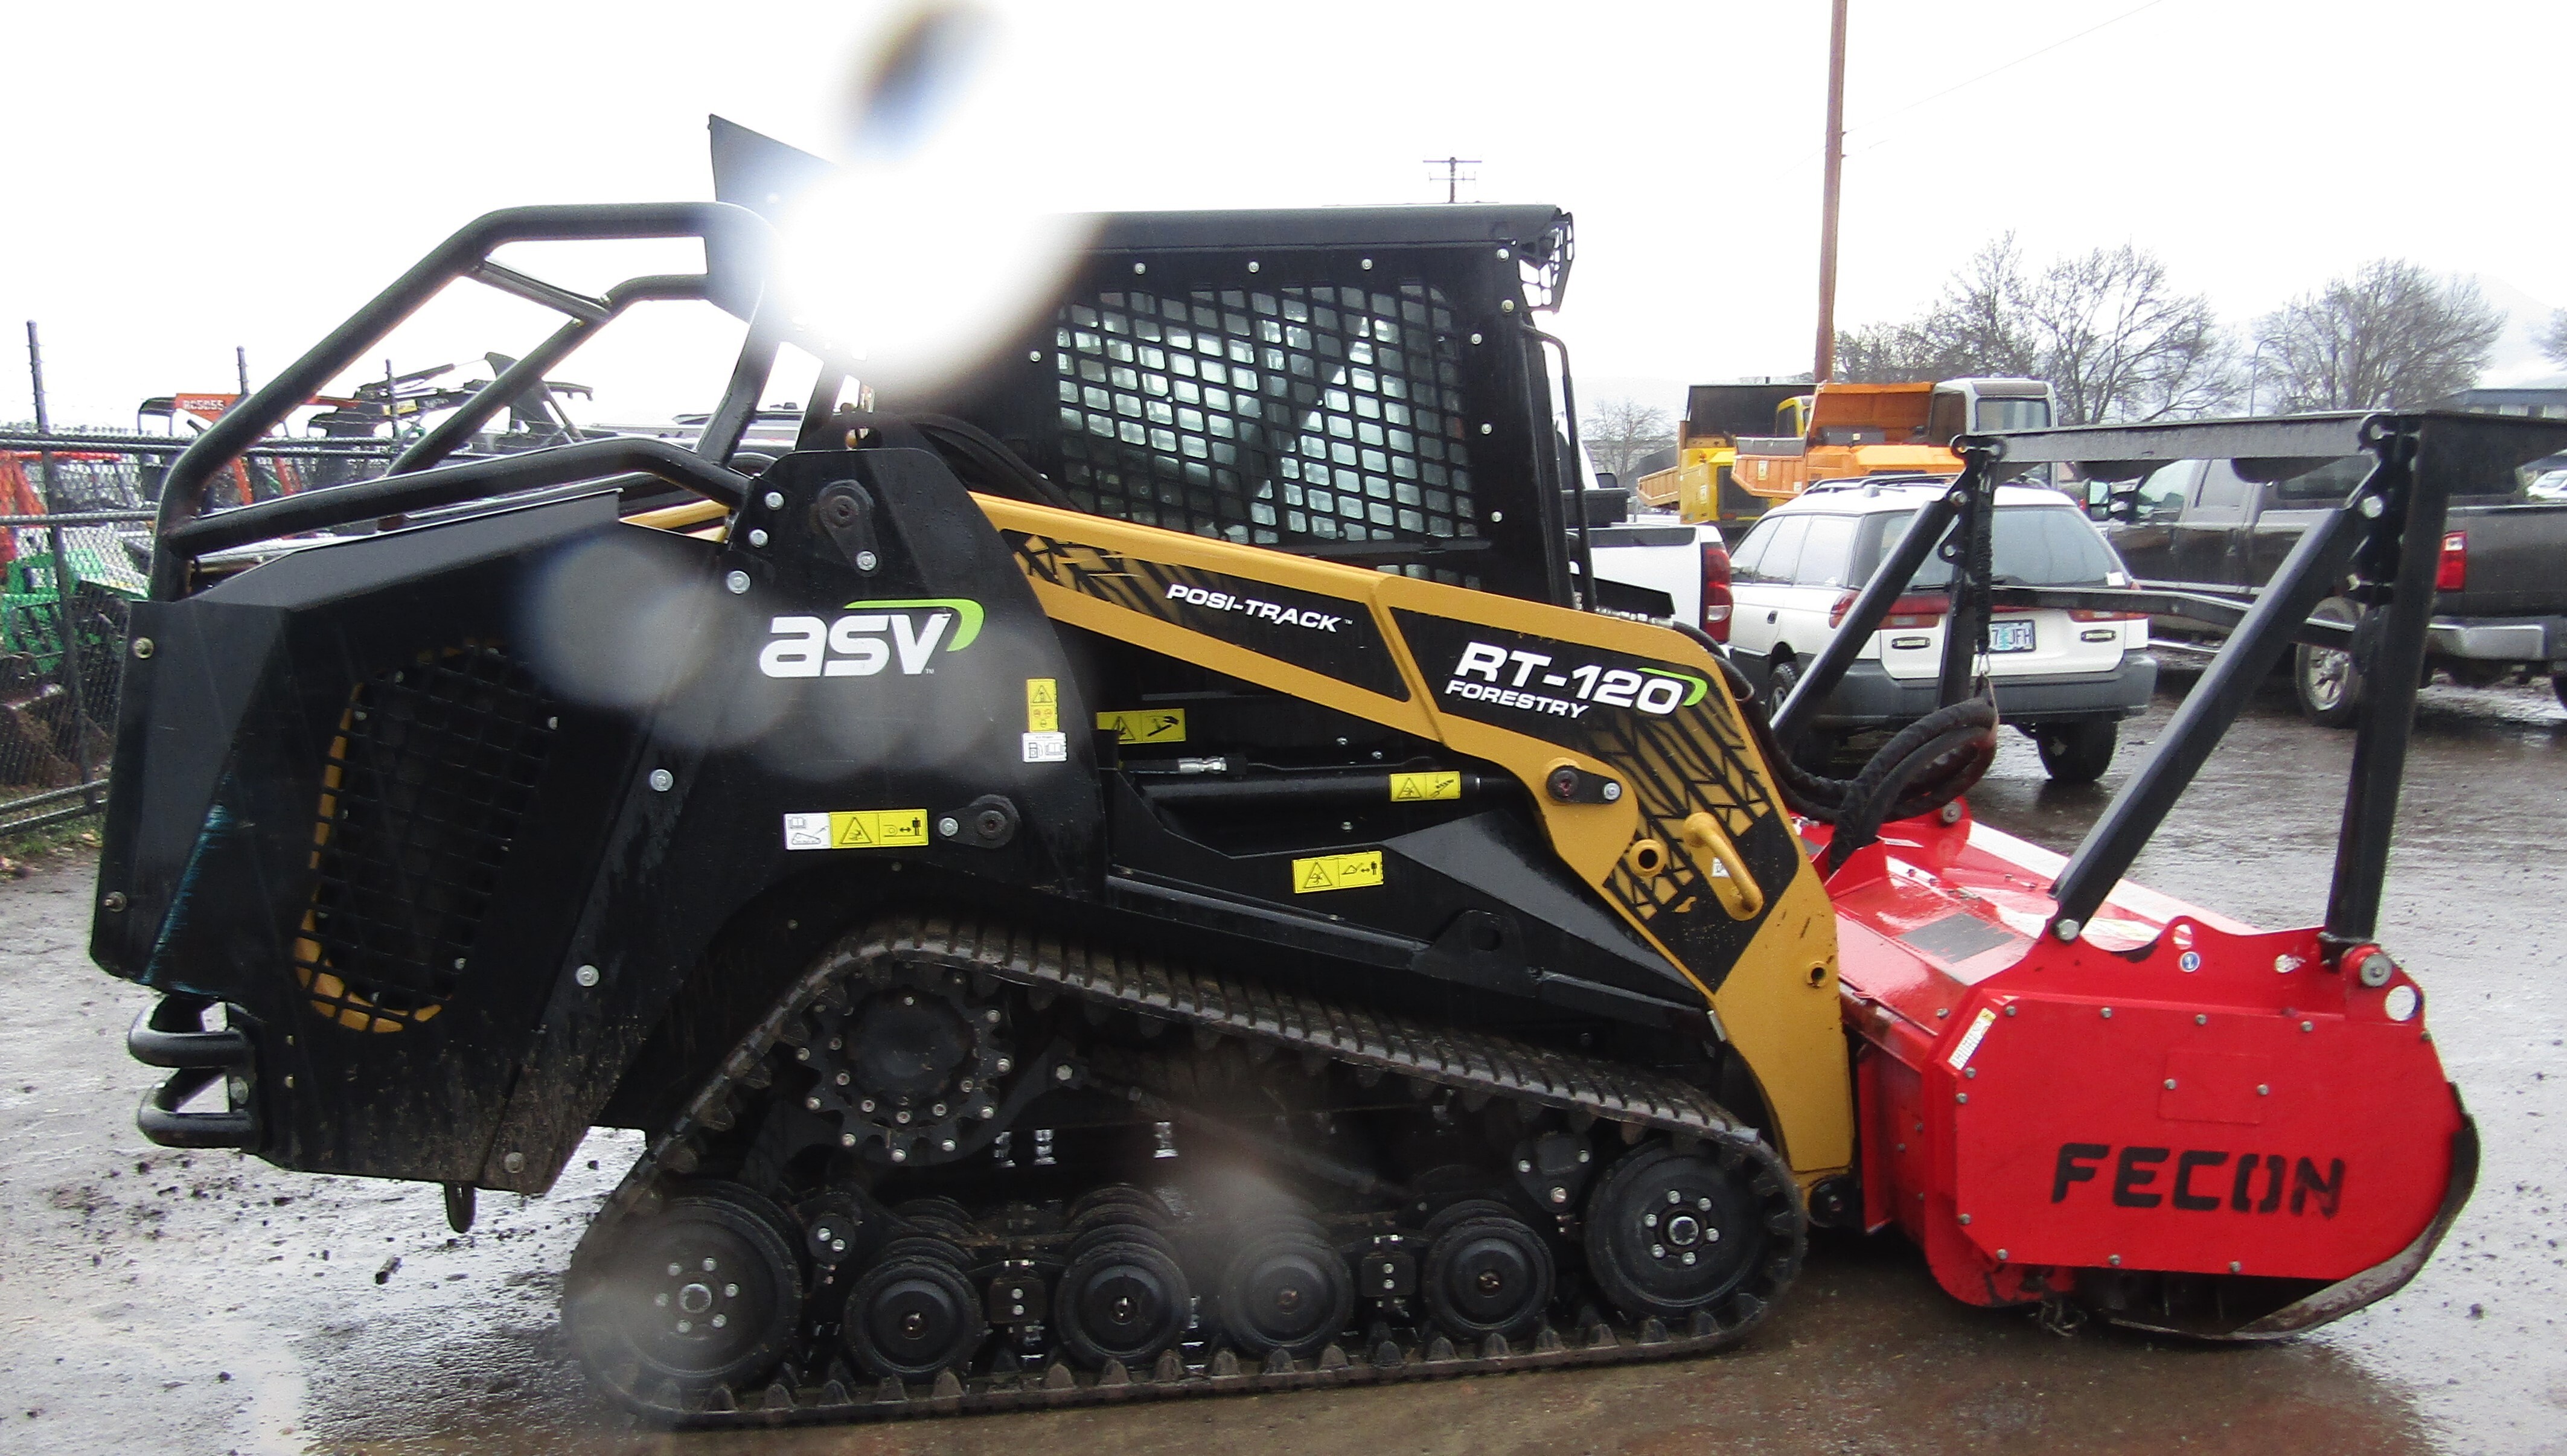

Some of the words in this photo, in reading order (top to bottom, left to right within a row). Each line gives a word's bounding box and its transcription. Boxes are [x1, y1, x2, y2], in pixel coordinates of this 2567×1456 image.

[1166, 584, 1341, 633] POSI-TRACK
[1445, 680, 1589, 718] FORESTRY
[1454, 642, 1684, 715] RT-120
[2051, 1142, 2345, 1219] FECON
